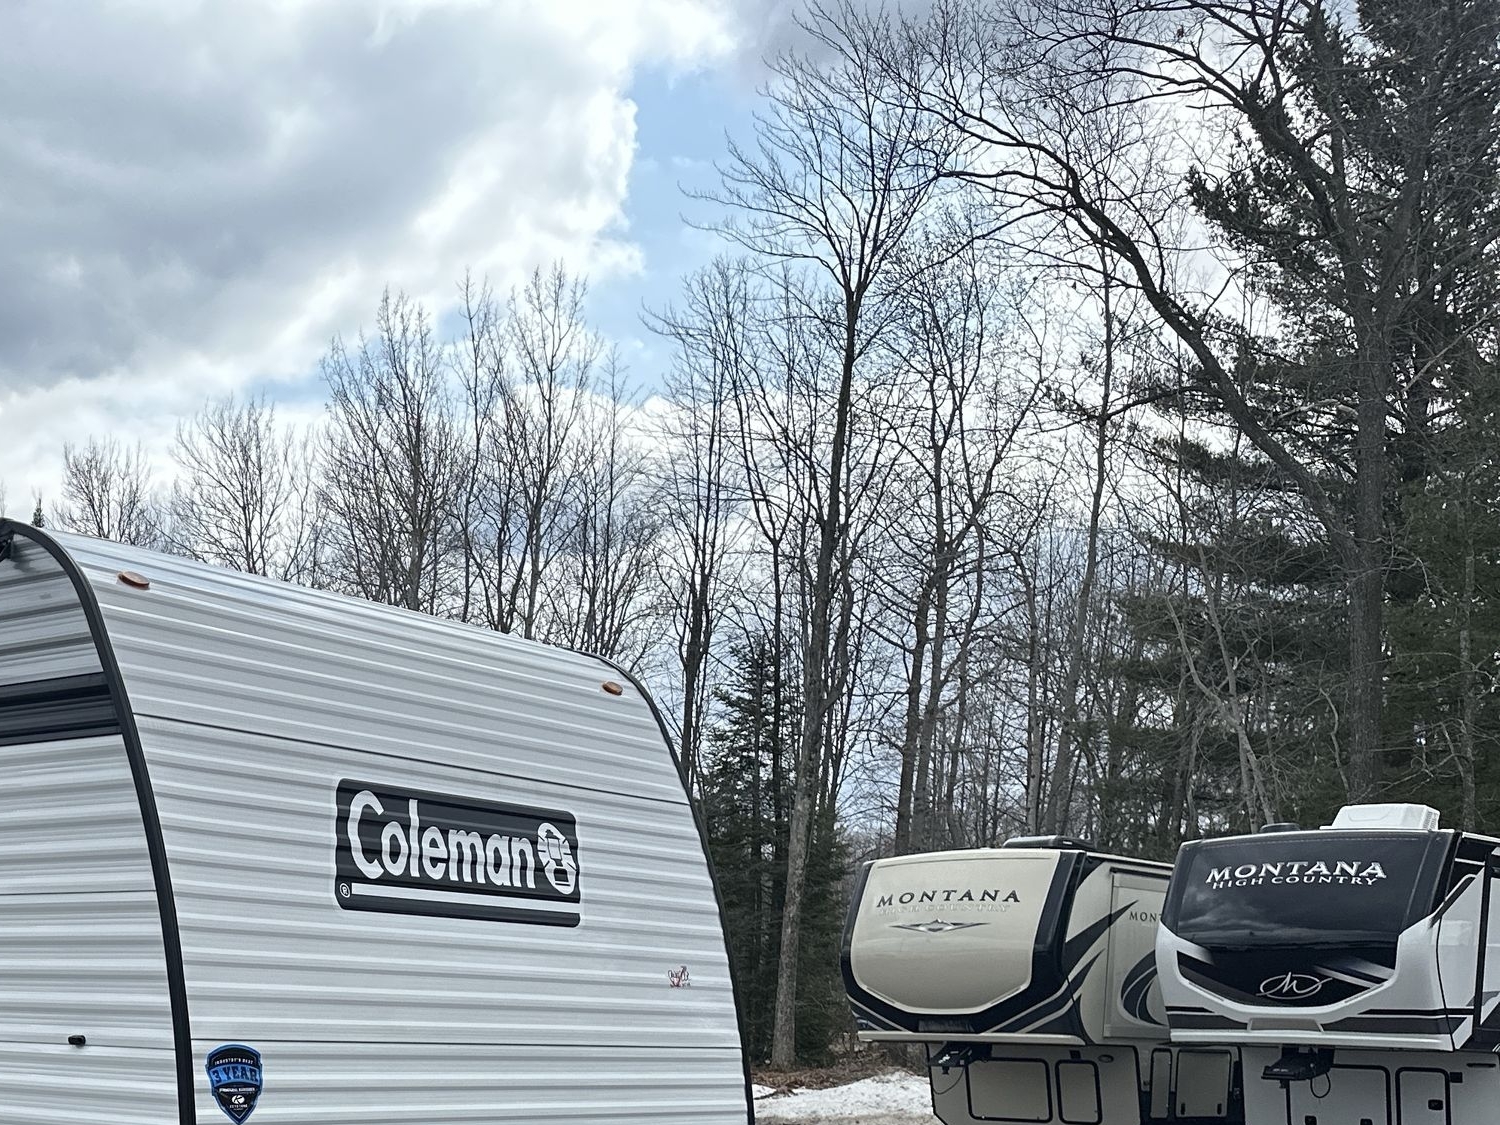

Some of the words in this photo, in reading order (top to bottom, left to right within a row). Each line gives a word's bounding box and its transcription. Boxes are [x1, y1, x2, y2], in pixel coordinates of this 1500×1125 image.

[347, 790, 537, 889] Coleman
[1205, 861, 1387, 884] MONTANA
[1212, 877, 1264, 890] HIGH
[1271, 876, 1379, 886] COUNTRY
[876, 889, 1021, 908] MONTANA
[212, 1069, 222, 1084] 3
[222, 1066, 258, 1082] YEAR
